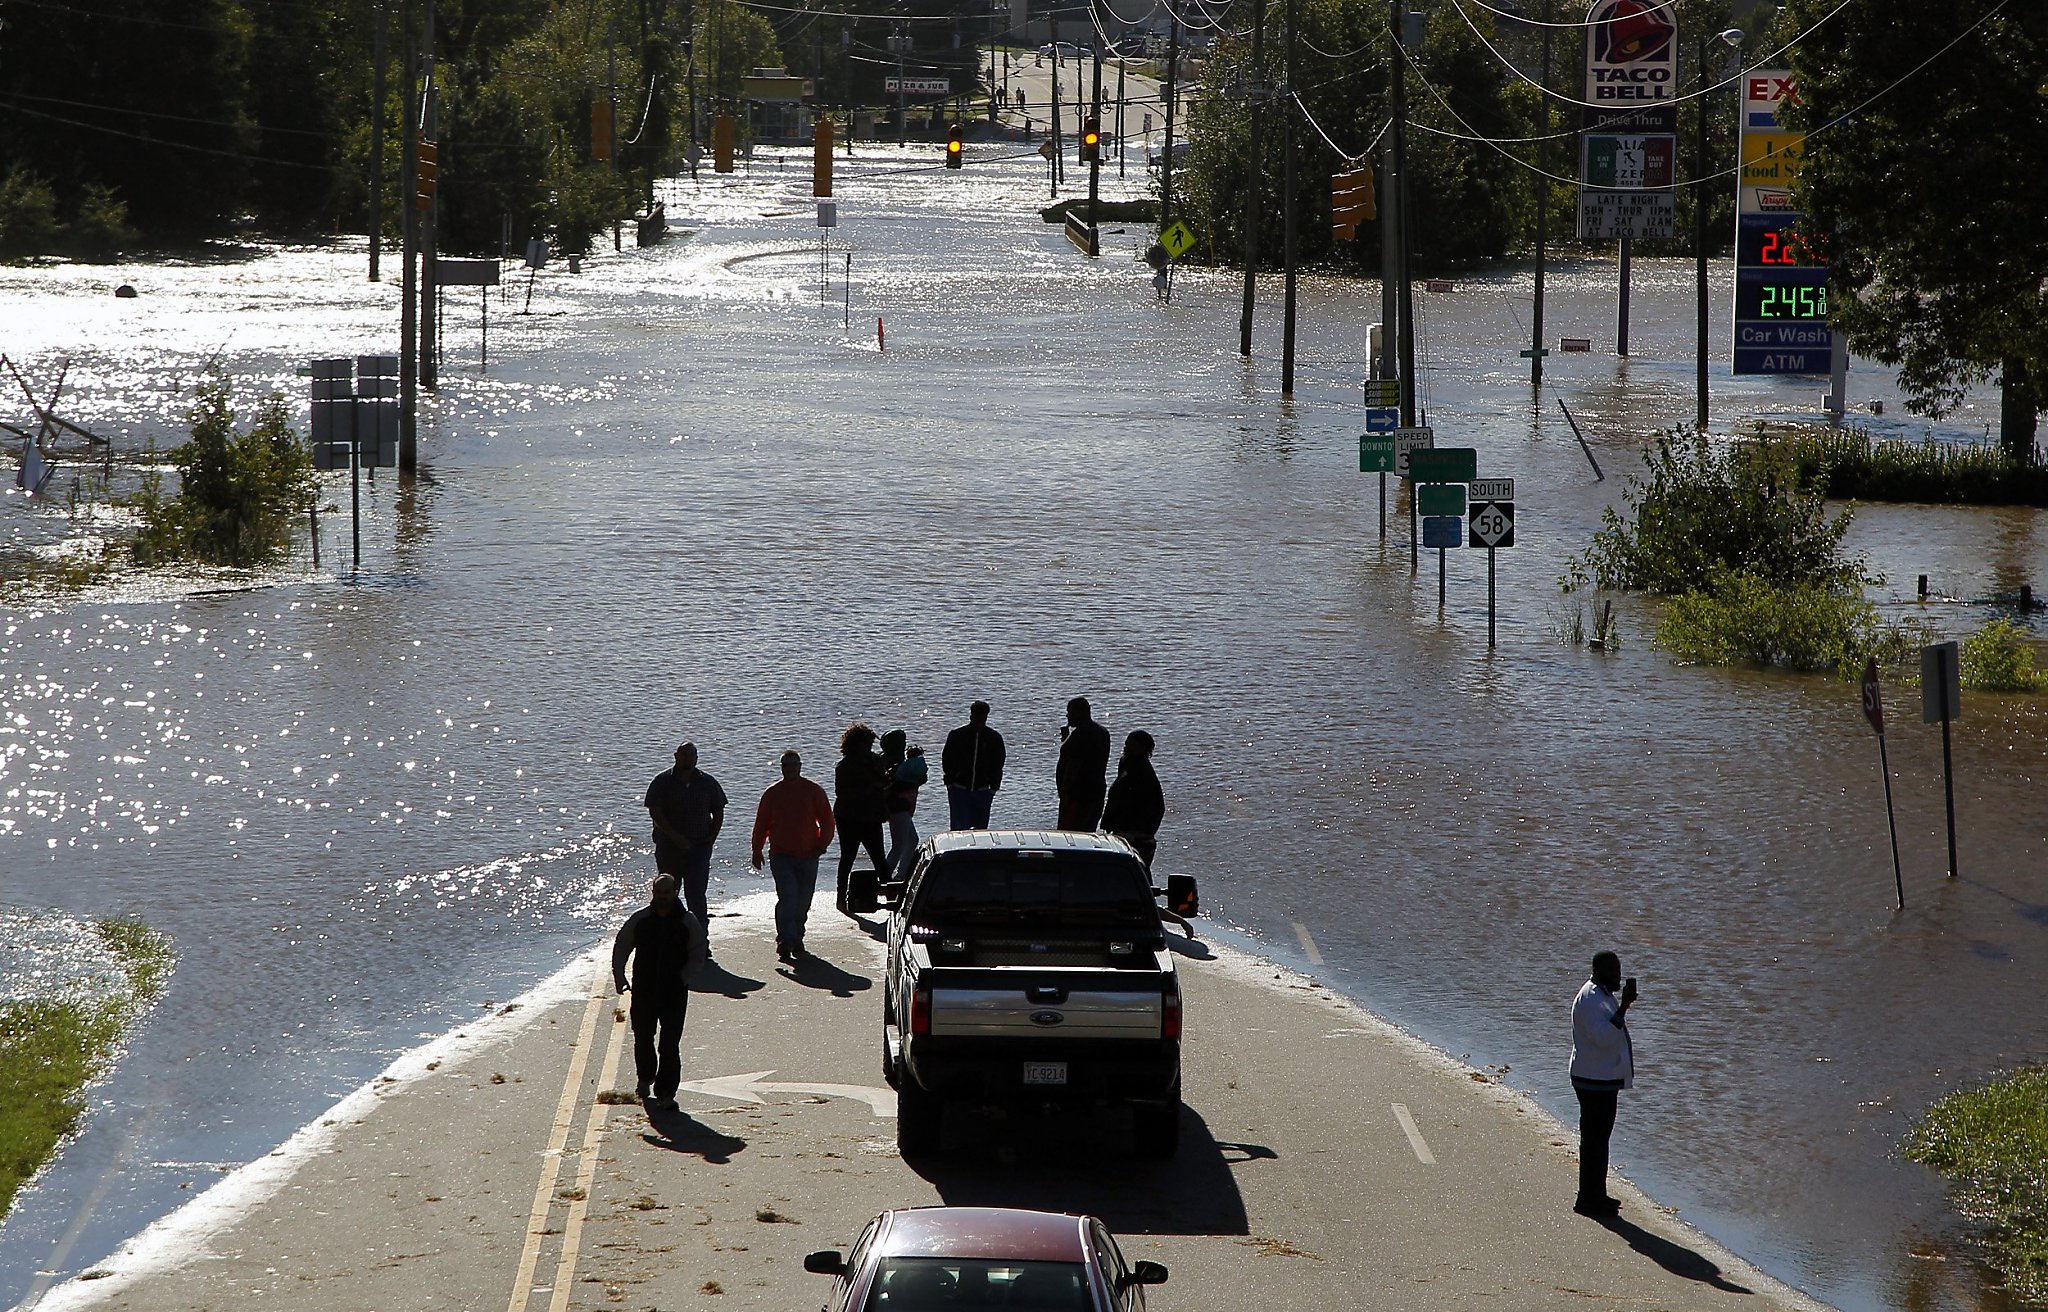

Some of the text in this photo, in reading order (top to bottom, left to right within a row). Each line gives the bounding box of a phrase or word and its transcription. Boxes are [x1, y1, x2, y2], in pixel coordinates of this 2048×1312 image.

[1591, 68, 1671, 82] TACO
[1596, 86, 1671, 99] BELL
[1598, 115, 1662, 125] Drive Thru
[1597, 196, 1660, 204] LATE NIGHT
[1584, 207, 1604, 215] SUN
[1617, 207, 1642, 215] THUR
[1650, 207, 1672, 215] 11PM
[1586, 217, 1673, 225] FRI SAT 12AM
[1587, 228, 1667, 236] AT TACO BELL
[1760, 287, 1814, 317] 2.45
[1742, 327, 1827, 342] Car Wash
[1762, 354, 1804, 369] ATM
[1366, 382, 1397, 390] SUBWAY
[1366, 390, 1398, 398] SUBWAY
[1366, 398, 1398, 406] SUBWAY
[1397, 433, 1429, 441] SPEED
[1361, 442, 1392, 451] DOWNTO
[1400, 442, 1425, 451] LIMIT
[1399, 453, 1410, 470] 3
[1472, 484, 1510, 496] SOUTH
[1480, 515, 1503, 535] 58
[1865, 682, 1880, 711] ST
